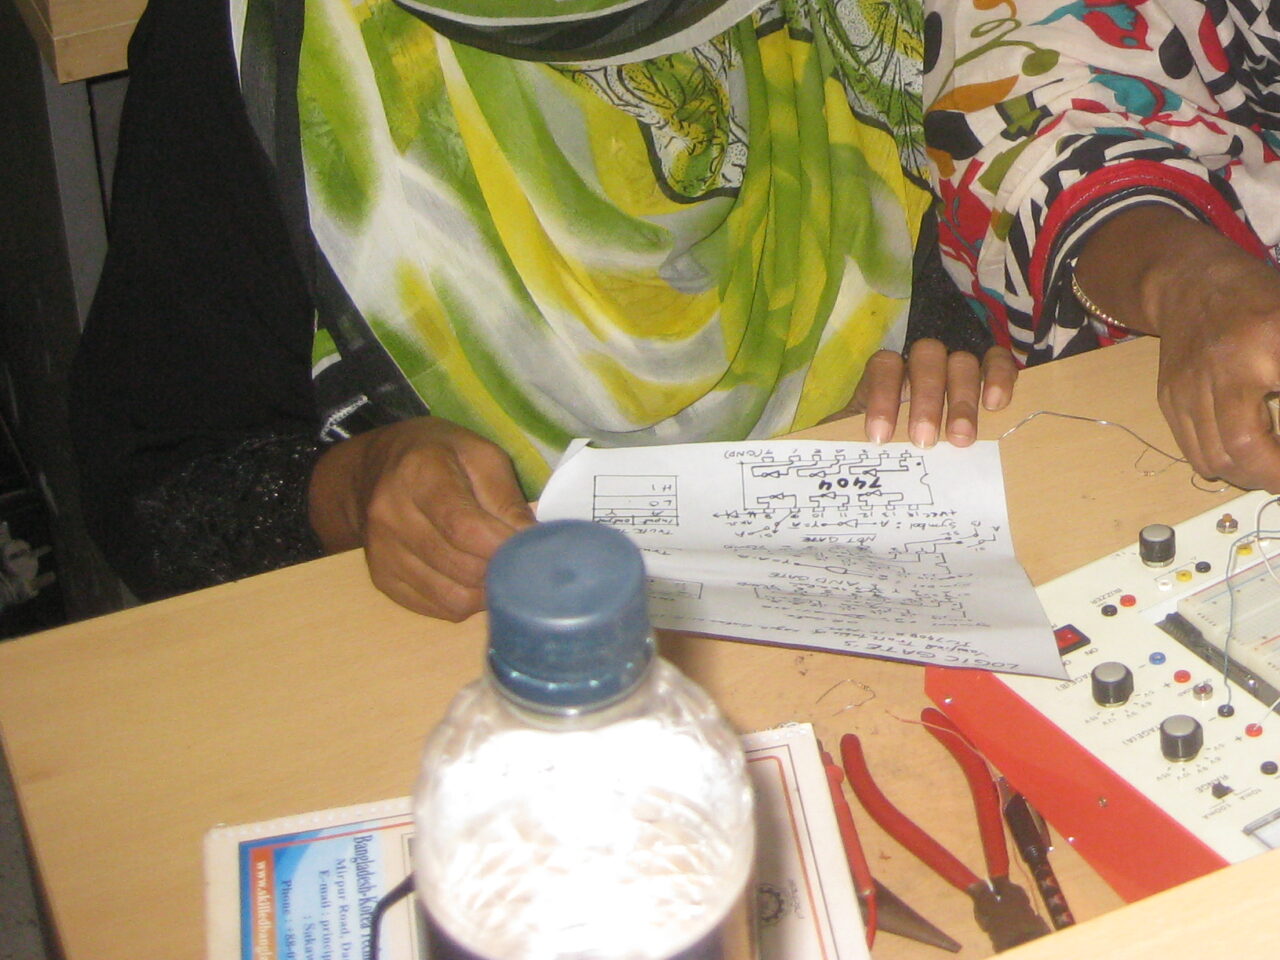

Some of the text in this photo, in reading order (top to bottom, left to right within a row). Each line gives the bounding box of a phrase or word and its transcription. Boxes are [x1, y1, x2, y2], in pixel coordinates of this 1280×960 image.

[819, 478, 881, 490] 7404
[944, 655, 1019, 670] LOGIC
[319, 870, 331, 909] E-mail
[335, 858, 348, 899] Mirpur
